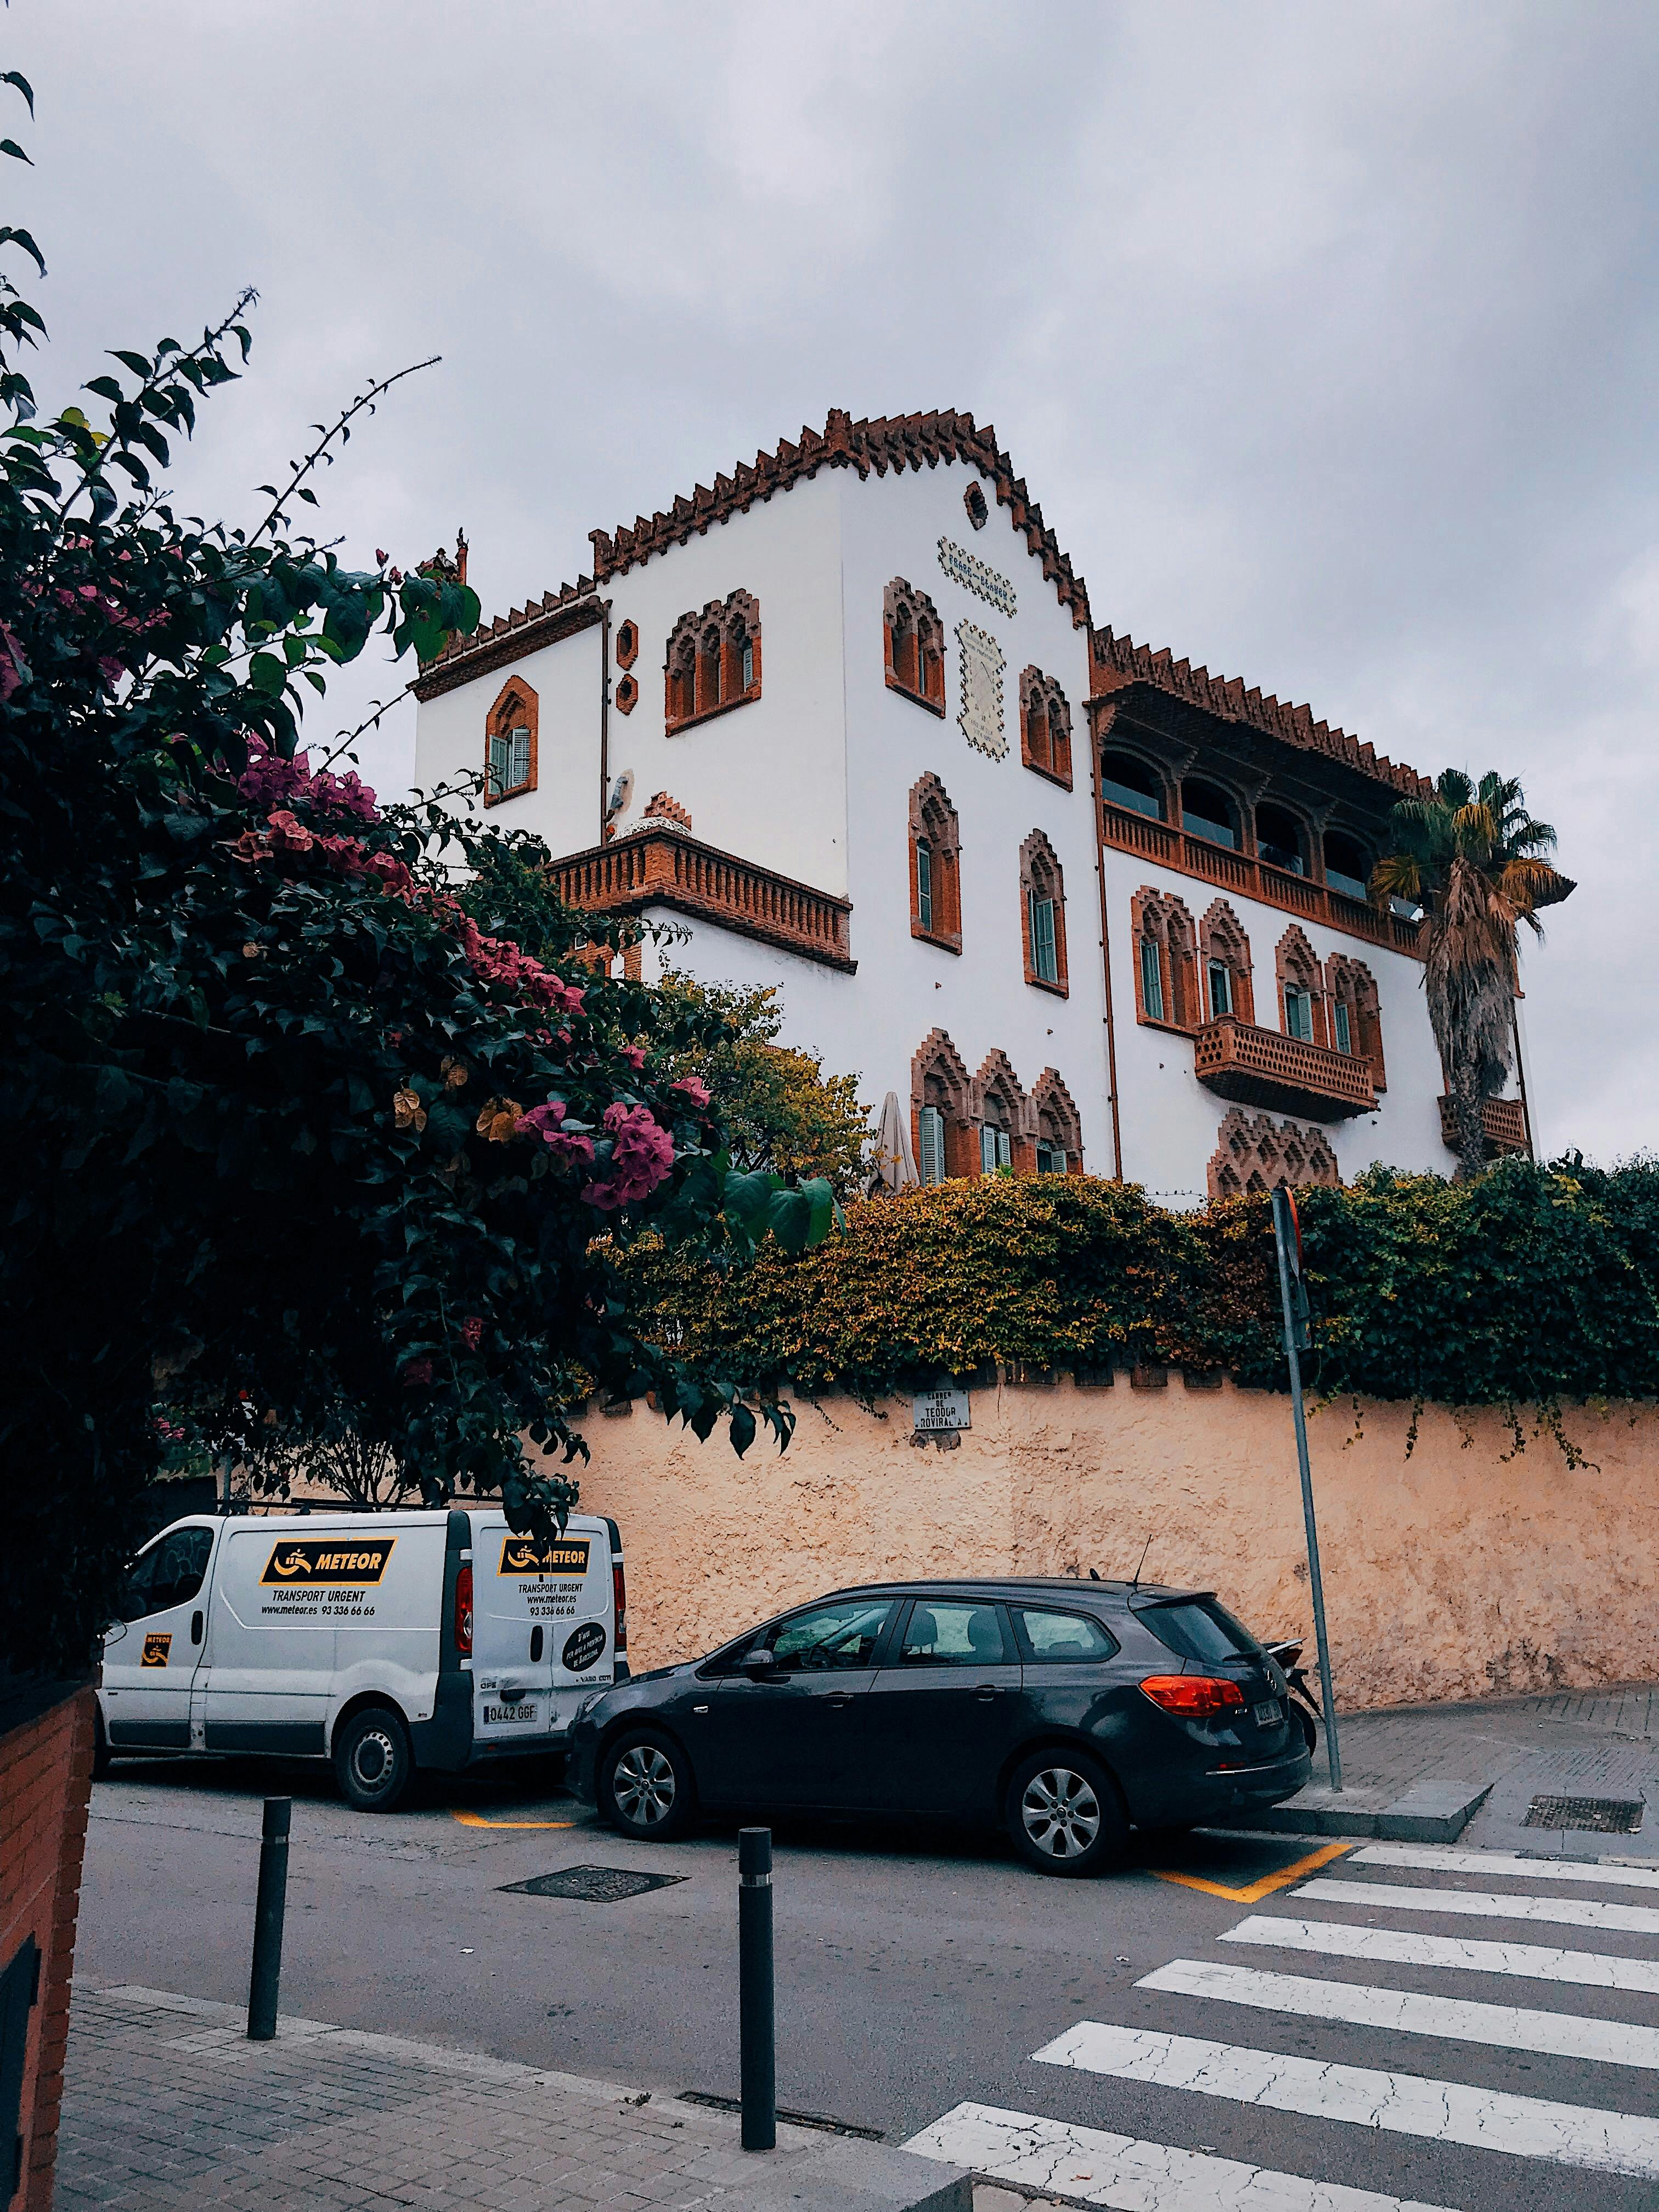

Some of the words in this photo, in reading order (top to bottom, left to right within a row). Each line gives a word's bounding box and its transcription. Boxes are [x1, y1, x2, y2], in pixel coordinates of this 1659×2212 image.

[925, 1407, 956, 1417] TEODOR
[921, 1417, 962, 1427] ROVIRALA
[315, 1553, 382, 1570] METEOR
[518, 1584, 557, 1594] TRANSPORT
[559, 1583, 583, 1592] URGENT
[273, 1590, 326, 1601] TRANSPORT
[328, 1590, 366, 1602] URGENT
[527, 1594, 577, 1604] www.meteor.es
[262, 1605, 318, 1615] www.meteor.es
[321, 1606, 331, 1615] 93
[334, 1606, 349, 1616] 336
[351, 1606, 362, 1616] 66
[363, 1606, 375, 1616] 66
[530, 1606, 539, 1616] 93
[541, 1606, 555, 1616] 336
[556, 1606, 565, 1615] 66
[566, 1606, 575, 1615] 66
[490, 1706, 515, 1721] 0442
[518, 1705, 535, 1719] GGF
